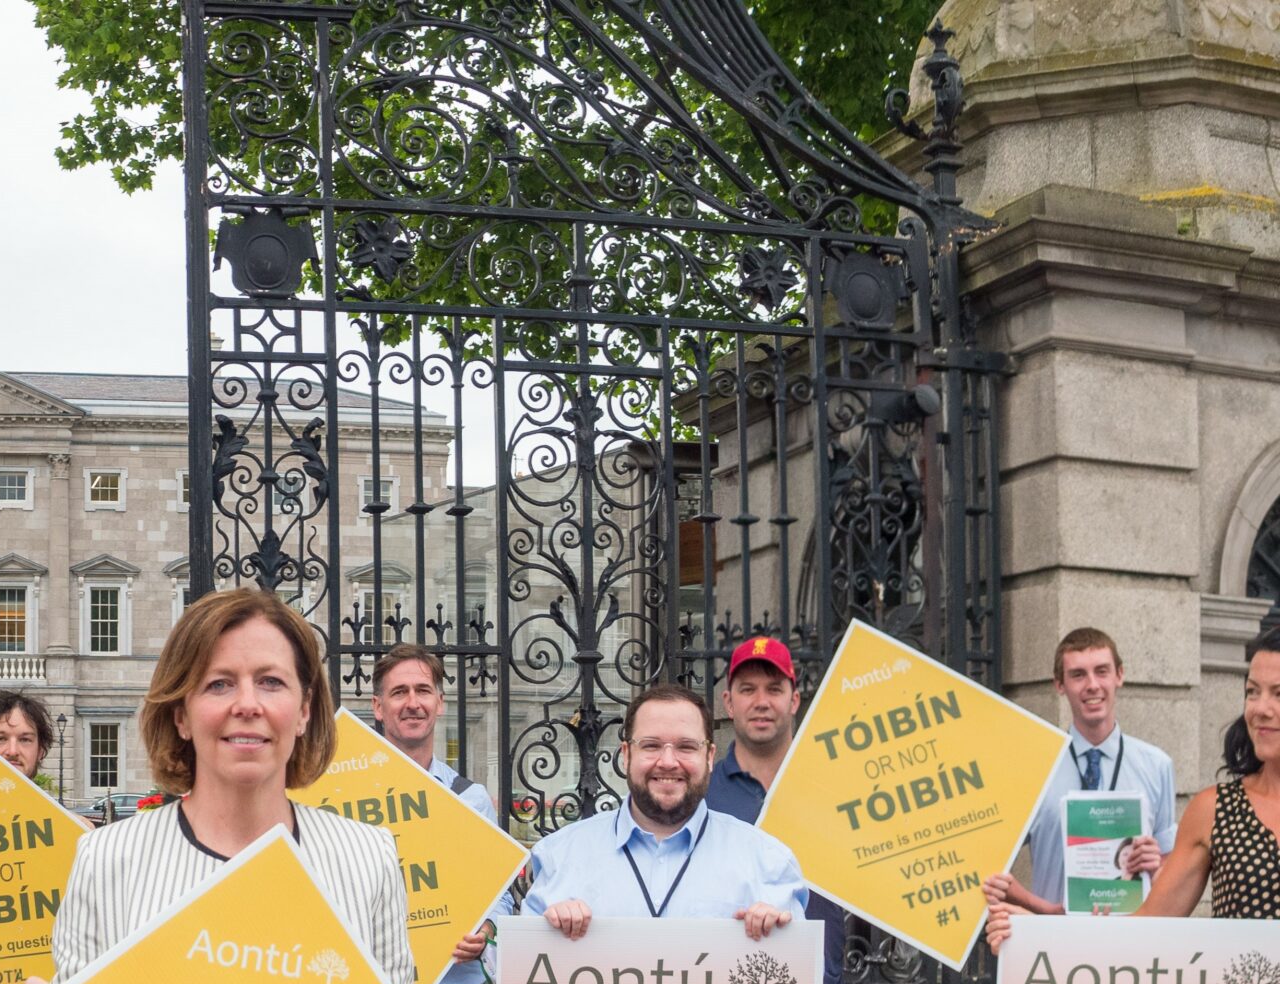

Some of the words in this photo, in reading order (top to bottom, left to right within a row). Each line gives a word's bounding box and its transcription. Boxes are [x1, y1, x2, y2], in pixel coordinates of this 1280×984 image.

[840, 662, 892, 694] Aontú
[814, 690, 962, 761] TÓIBÍN
[864, 755, 895, 780] OR
[898, 739, 937, 769] NOT
[317, 787, 429, 826] IBÍN
[836, 760, 984, 831] TÓIBÍN
[853, 840, 893, 860] There
[897, 834, 910, 847] is
[913, 828, 931, 841] no
[936, 803, 999, 835] question!
[900, 850, 965, 880] VÓTÁIL
[902, 871, 981, 909] TÓÍBÍN
[406, 904, 448, 921] stion!
[936, 905, 960, 927] #1
[7, 935, 53, 952] questi
[187, 929, 303, 978] Aontú
